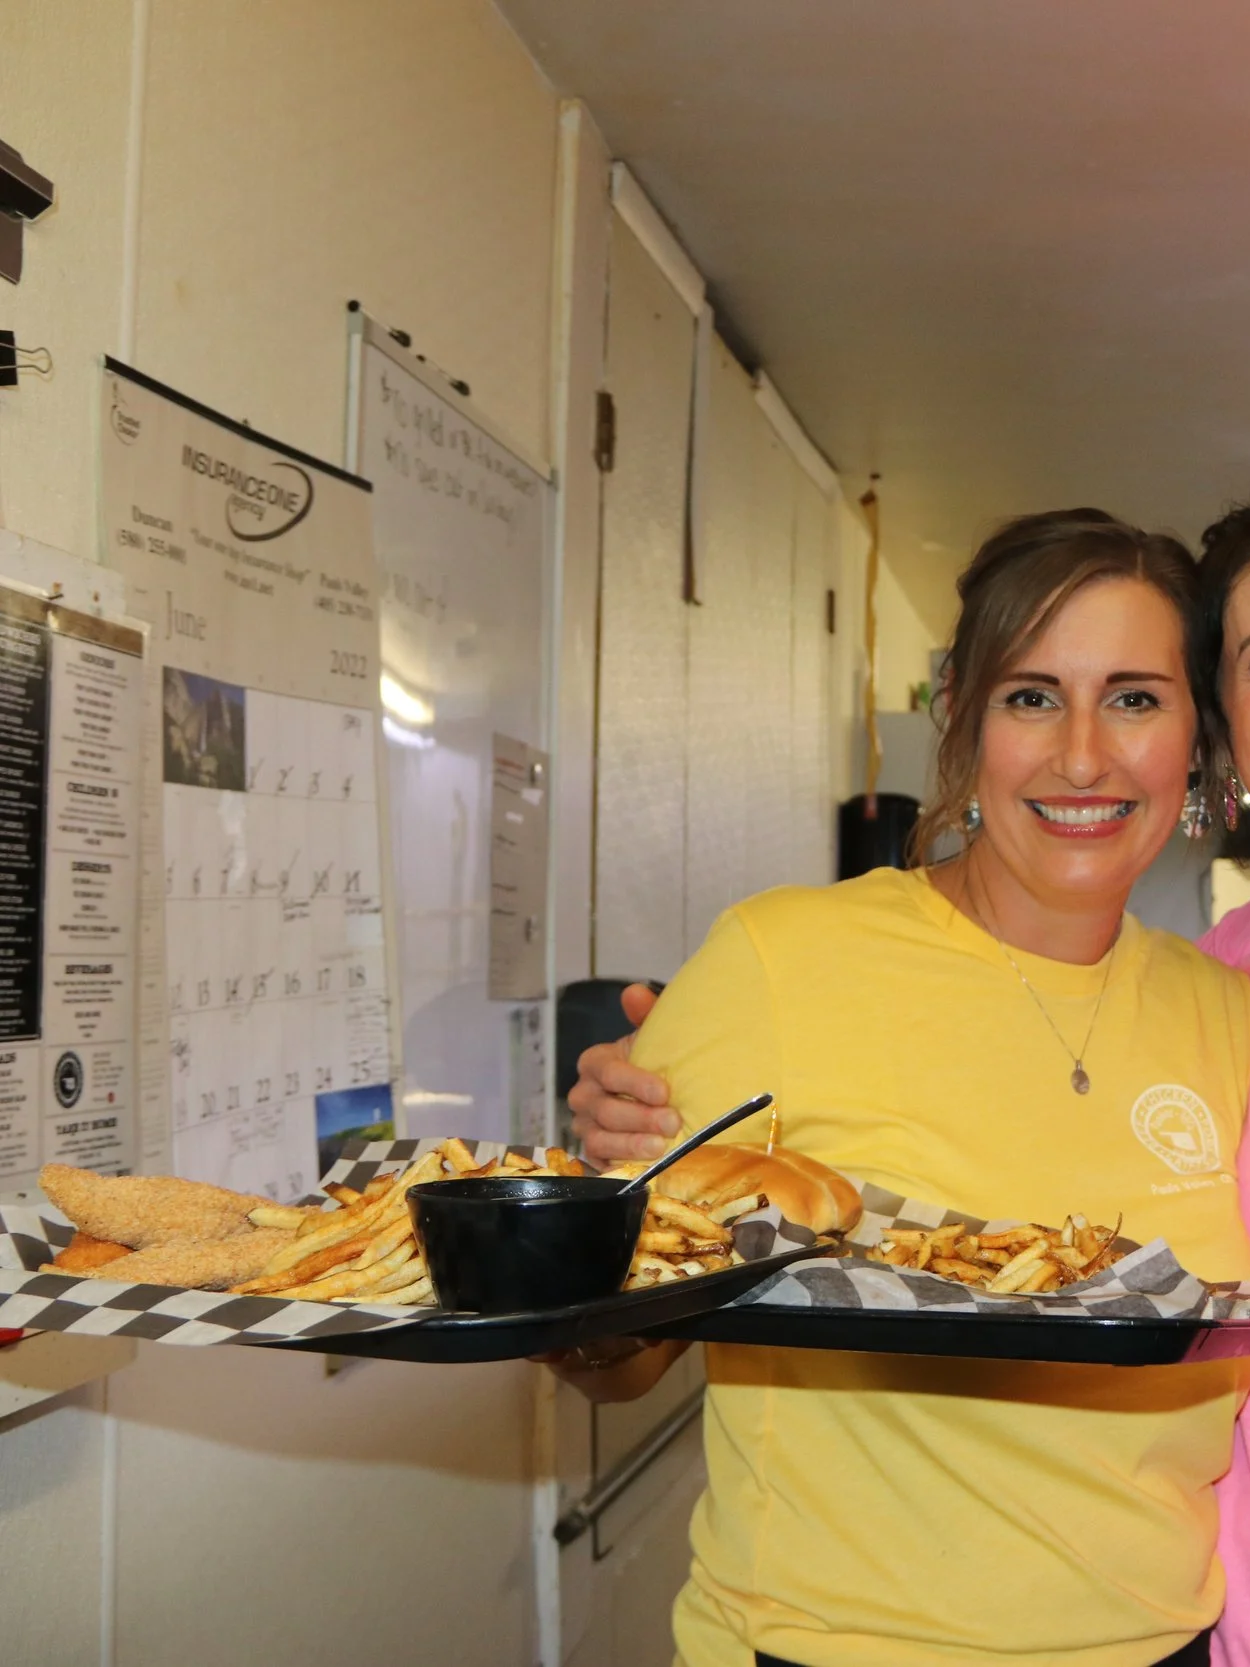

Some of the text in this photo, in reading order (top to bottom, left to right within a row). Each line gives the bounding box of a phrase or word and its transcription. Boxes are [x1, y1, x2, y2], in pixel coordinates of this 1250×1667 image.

[131, 504, 173, 534] Duncan
[165, 589, 207, 641] June
[330, 649, 368, 679] 2022
[285, 971, 301, 995] 16
[317, 967, 332, 991] 17
[348, 965, 367, 988] 18
[201, 1091, 216, 1119] 20
[226, 1086, 240, 1111] 21
[256, 1078, 271, 1103] 22
[285, 1072, 299, 1096] 23
[316, 1066, 332, 1090] 24
[351, 1060, 371, 1083] 25
